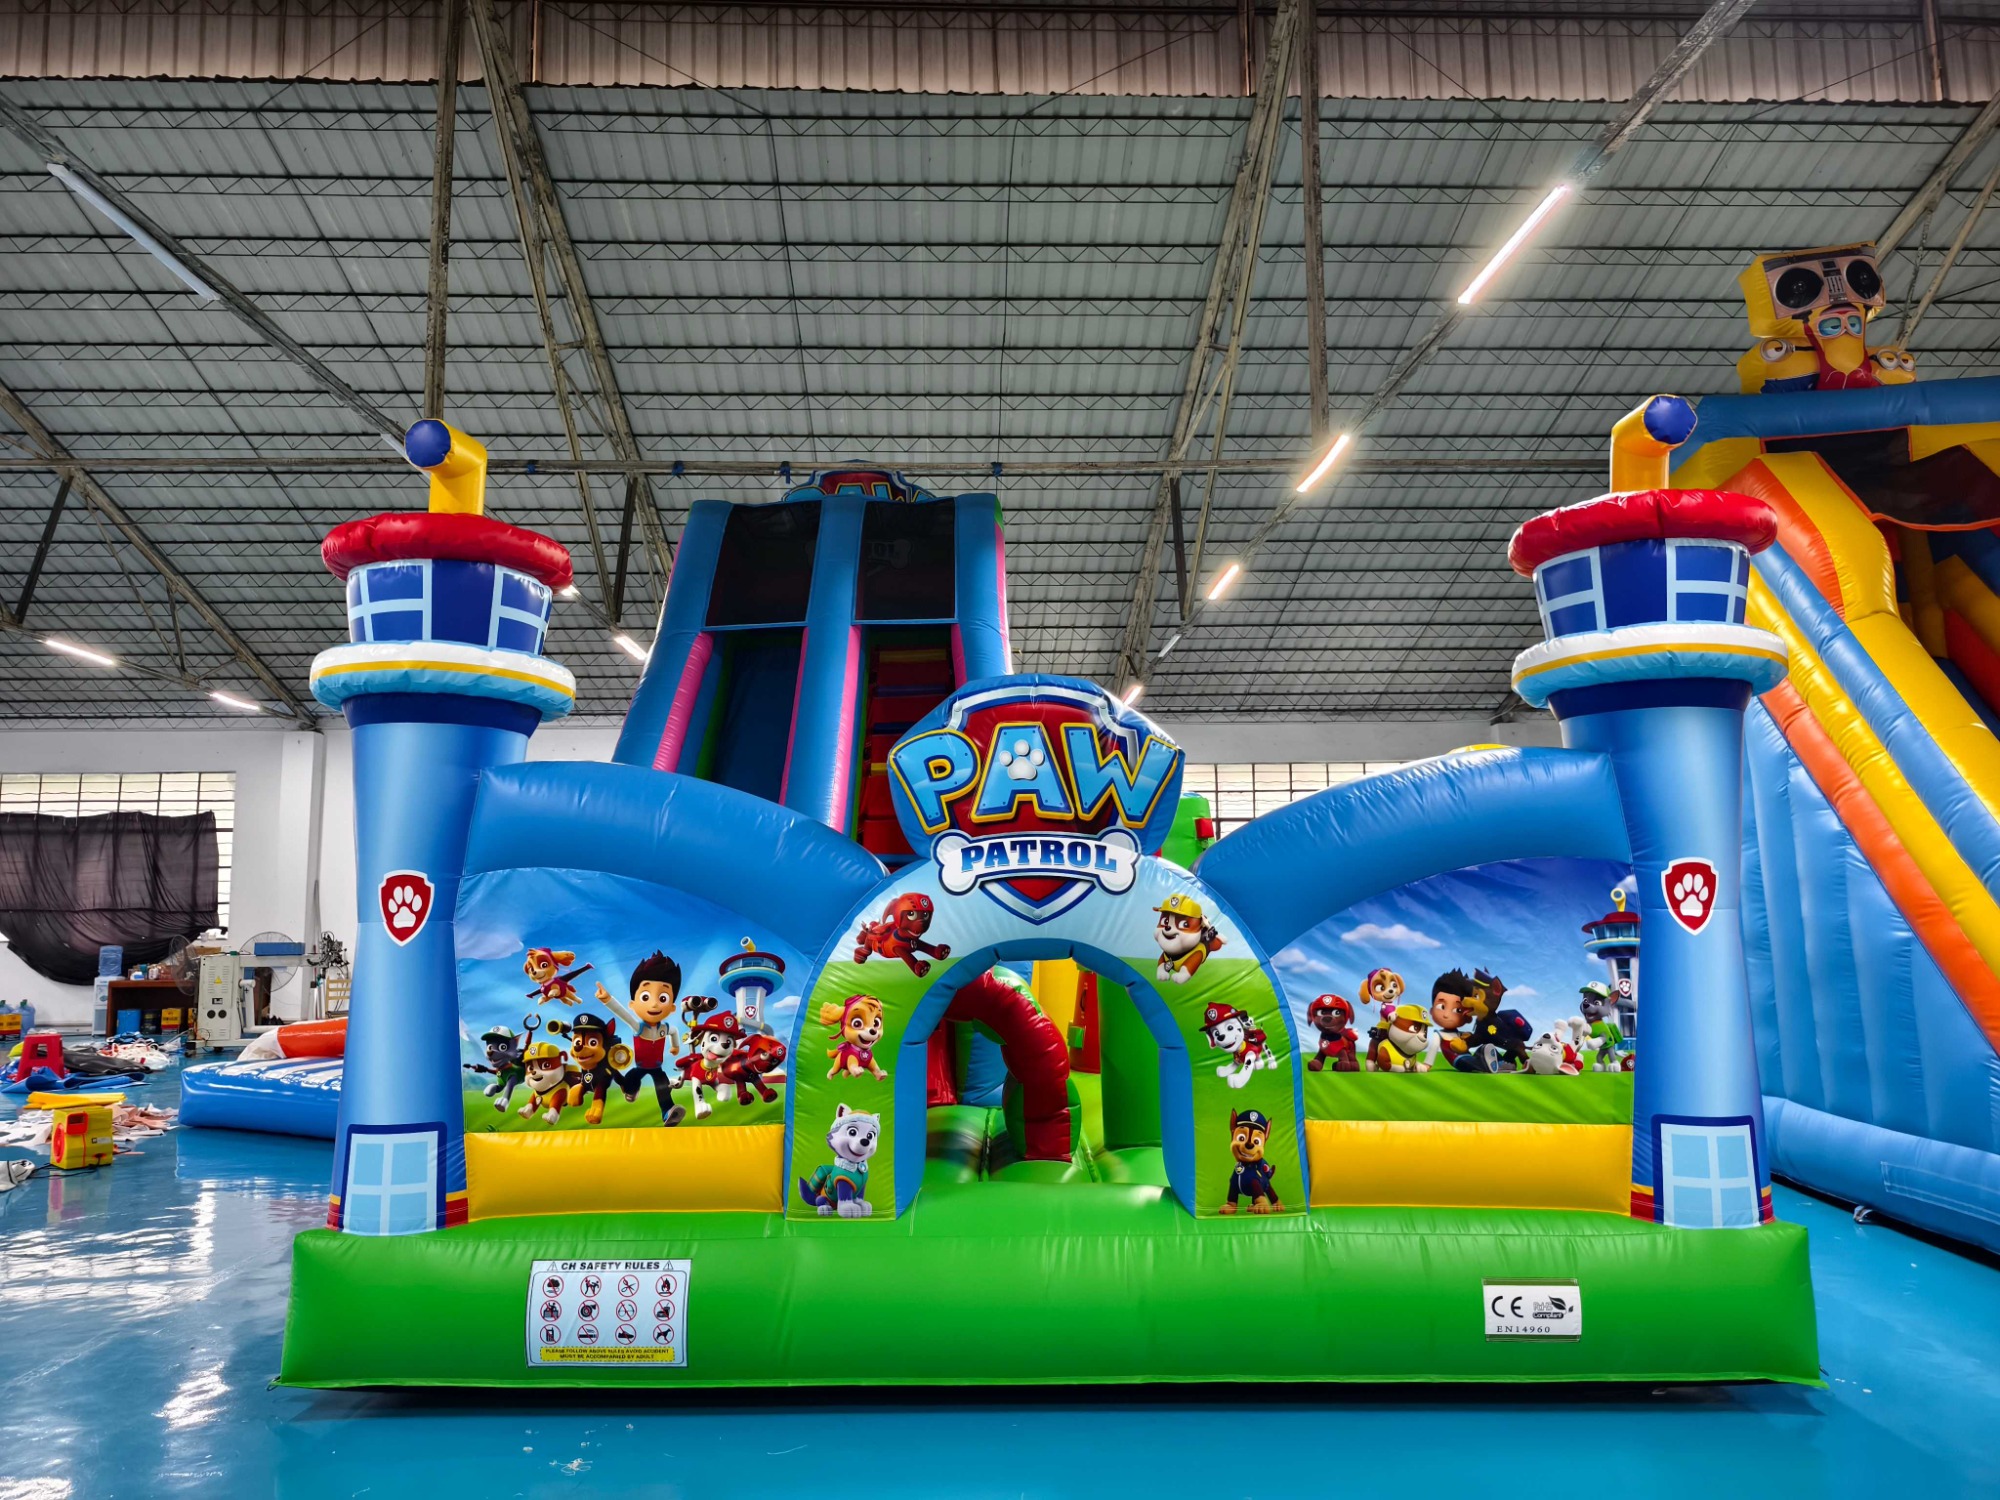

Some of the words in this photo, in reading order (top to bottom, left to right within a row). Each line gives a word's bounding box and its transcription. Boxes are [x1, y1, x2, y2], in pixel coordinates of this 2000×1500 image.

[889, 721, 1180, 834] PAW
[960, 839, 1117, 873] PATROL
[561, 1262, 577, 1270] CH
[580, 1262, 621, 1270] SAFETY
[625, 1261, 660, 1270] RULES
[1491, 1295, 1524, 1318] CE
